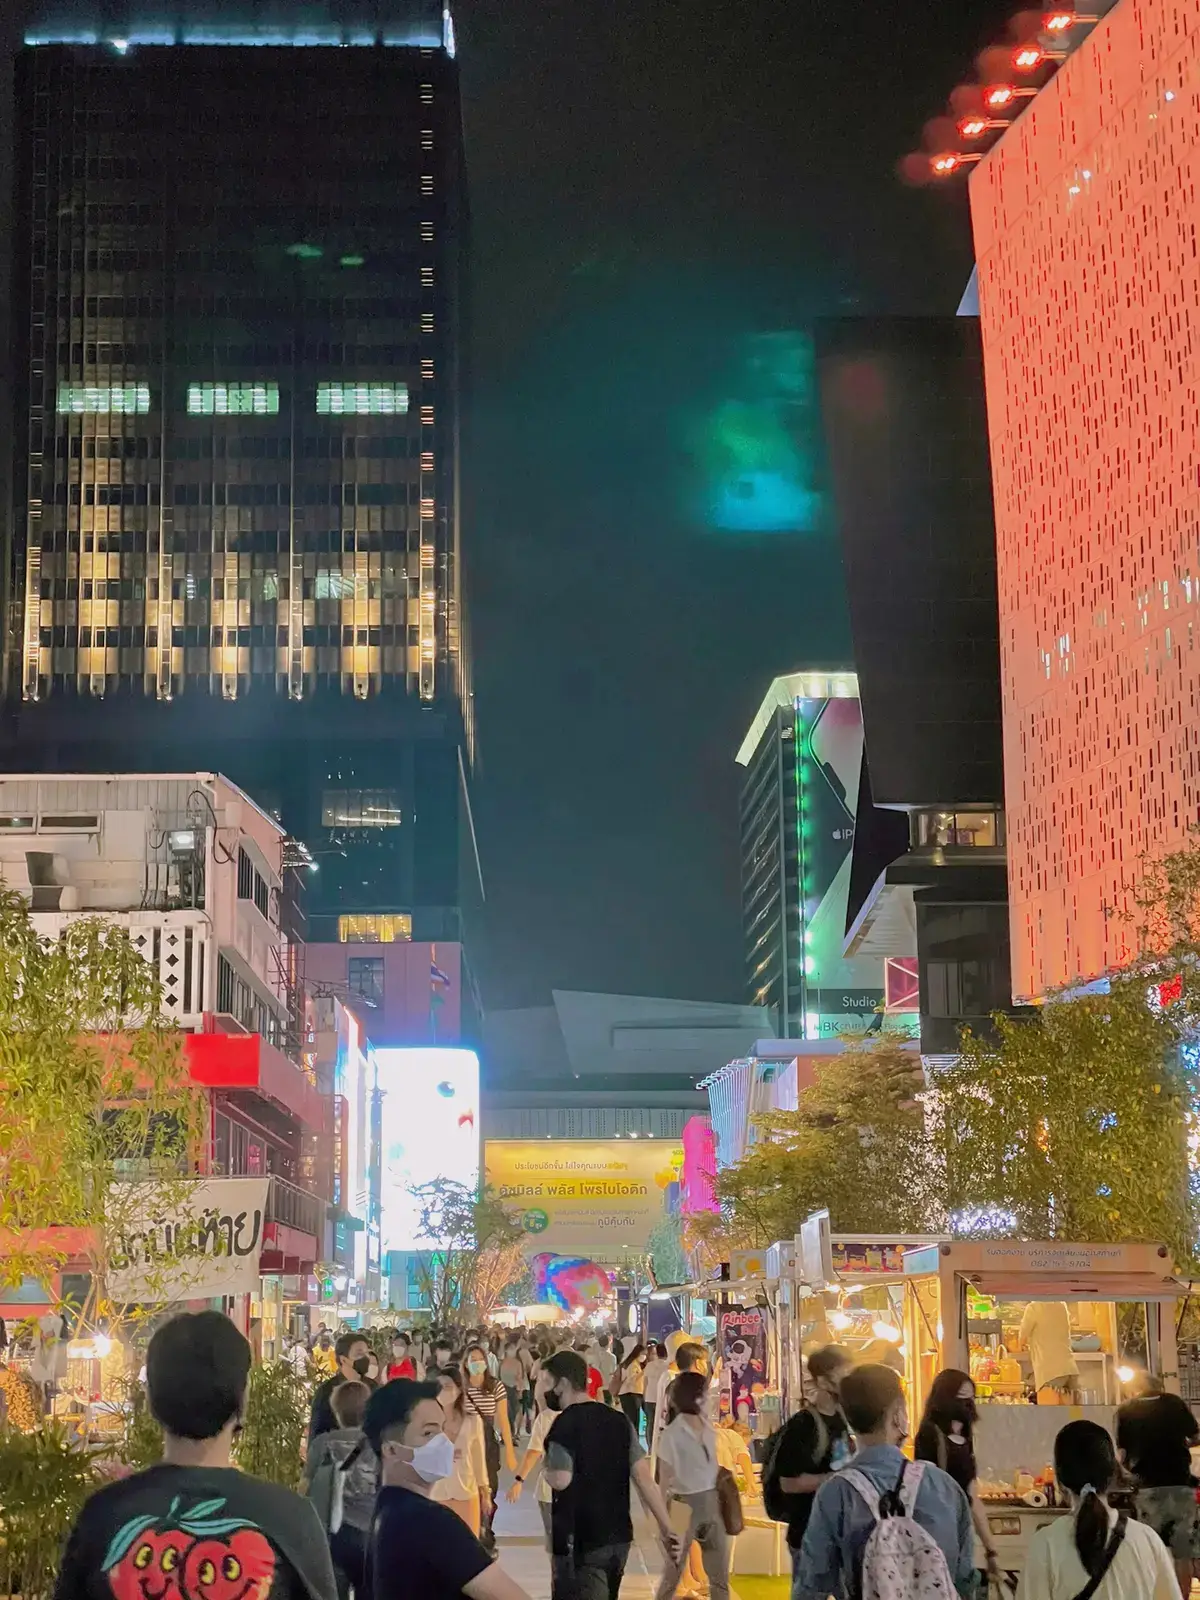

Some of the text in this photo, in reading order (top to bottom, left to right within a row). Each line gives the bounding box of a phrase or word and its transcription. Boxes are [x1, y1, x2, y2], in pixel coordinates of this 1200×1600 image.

[842, 995, 877, 1007] Studio
[547, 1183, 576, 1196] พลัส
[721, 1312, 761, 1332] Rinbee
